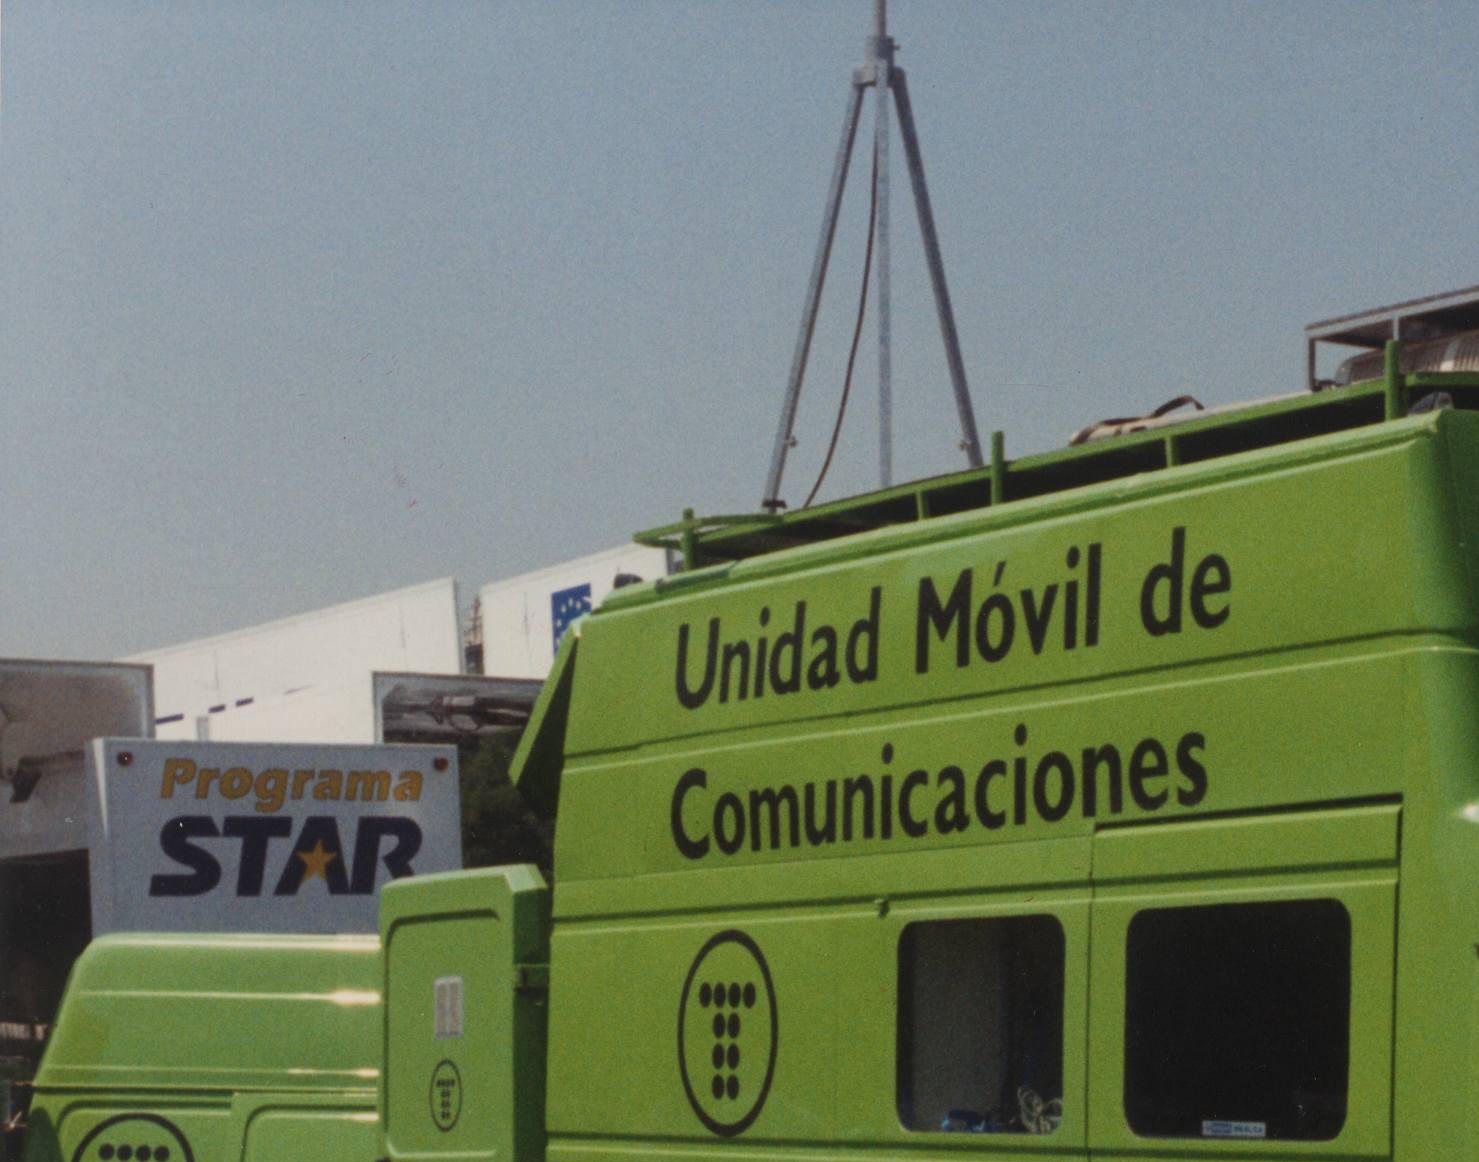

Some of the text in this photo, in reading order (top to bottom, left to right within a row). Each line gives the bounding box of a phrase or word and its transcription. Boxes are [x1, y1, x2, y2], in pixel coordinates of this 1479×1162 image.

[675, 526, 1232, 710] Unidad Móvil de
[160, 757, 423, 813] Programa
[670, 723, 1209, 860] Comunicaciones
[149, 815, 422, 897] STAR
